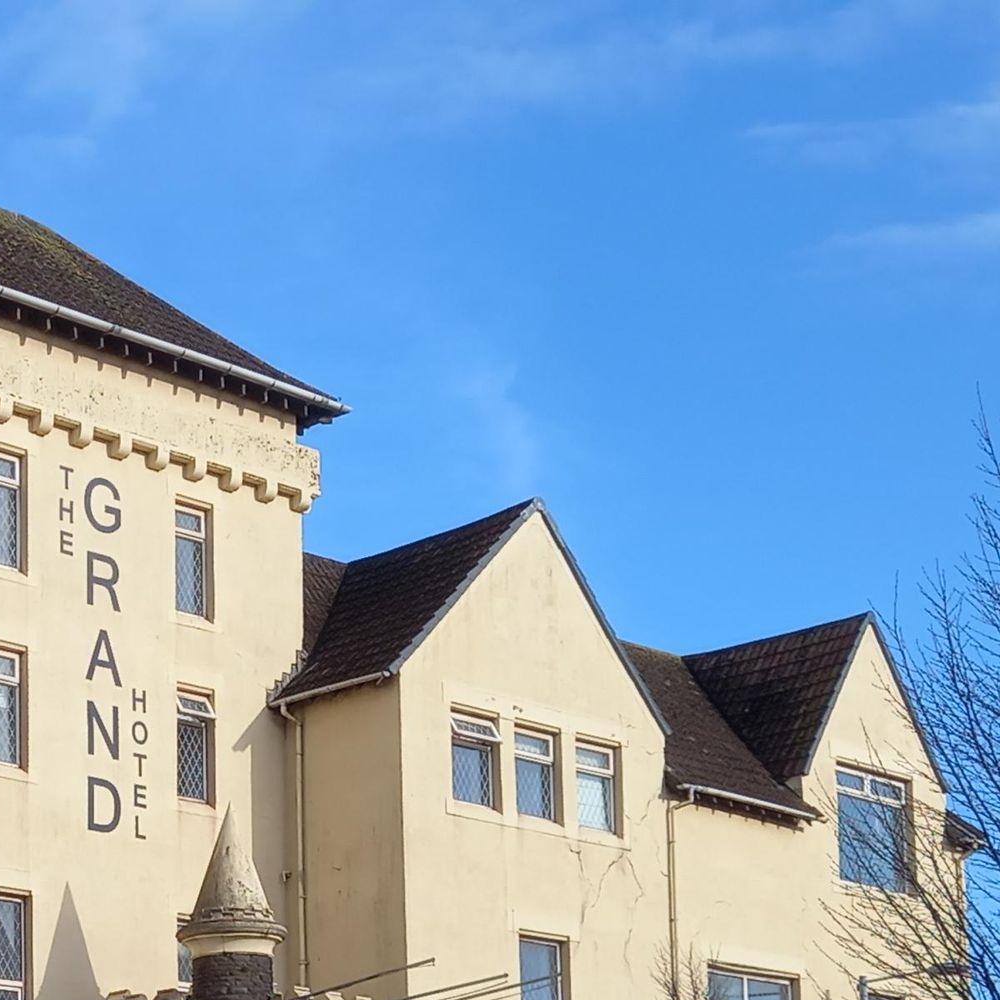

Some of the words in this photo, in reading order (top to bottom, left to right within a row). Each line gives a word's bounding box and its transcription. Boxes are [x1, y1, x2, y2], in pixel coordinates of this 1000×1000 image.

[59, 464, 74, 556] THE
[84, 477, 122, 833] GRAND
[131, 688, 148, 841] HOTEL
